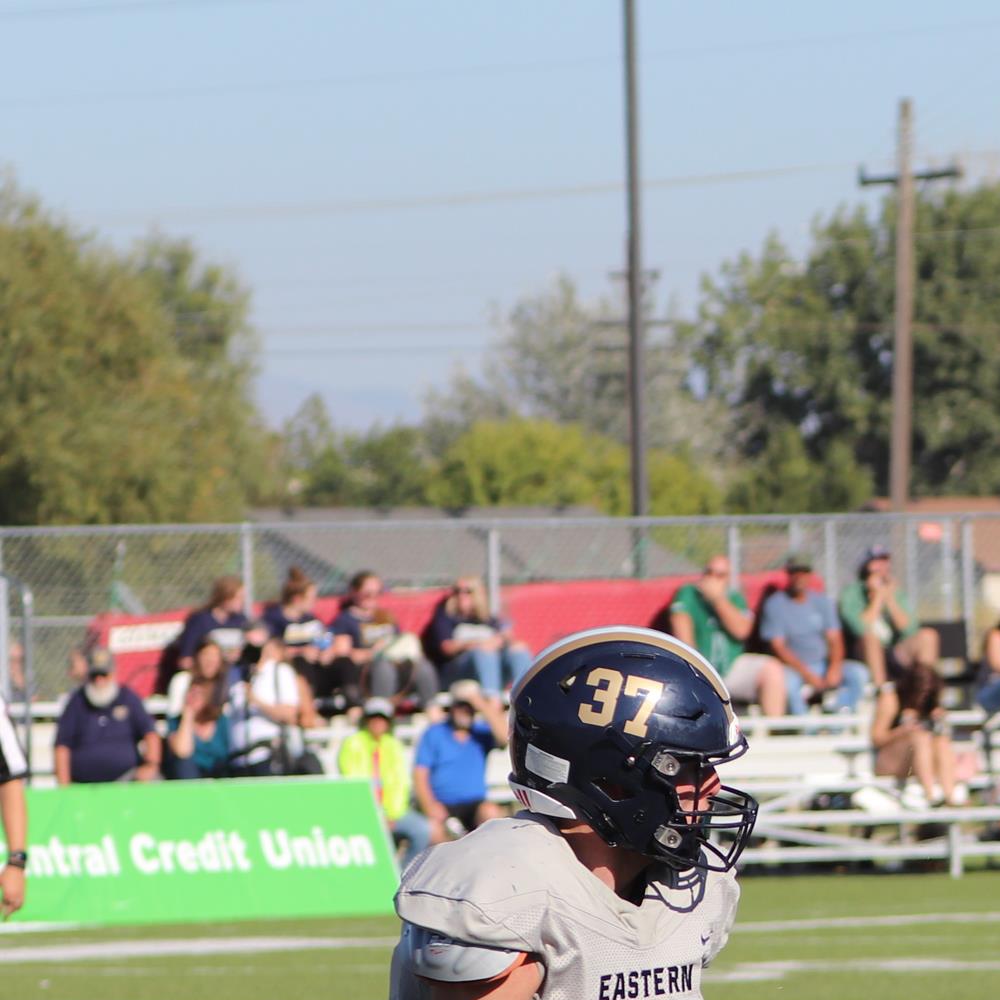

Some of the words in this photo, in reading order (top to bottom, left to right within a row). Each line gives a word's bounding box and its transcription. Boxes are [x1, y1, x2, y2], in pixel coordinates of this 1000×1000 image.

[577, 667, 665, 738] 37
[0, 834, 122, 876] ntral
[129, 829, 252, 875] Credit
[257, 826, 376, 869] Union
